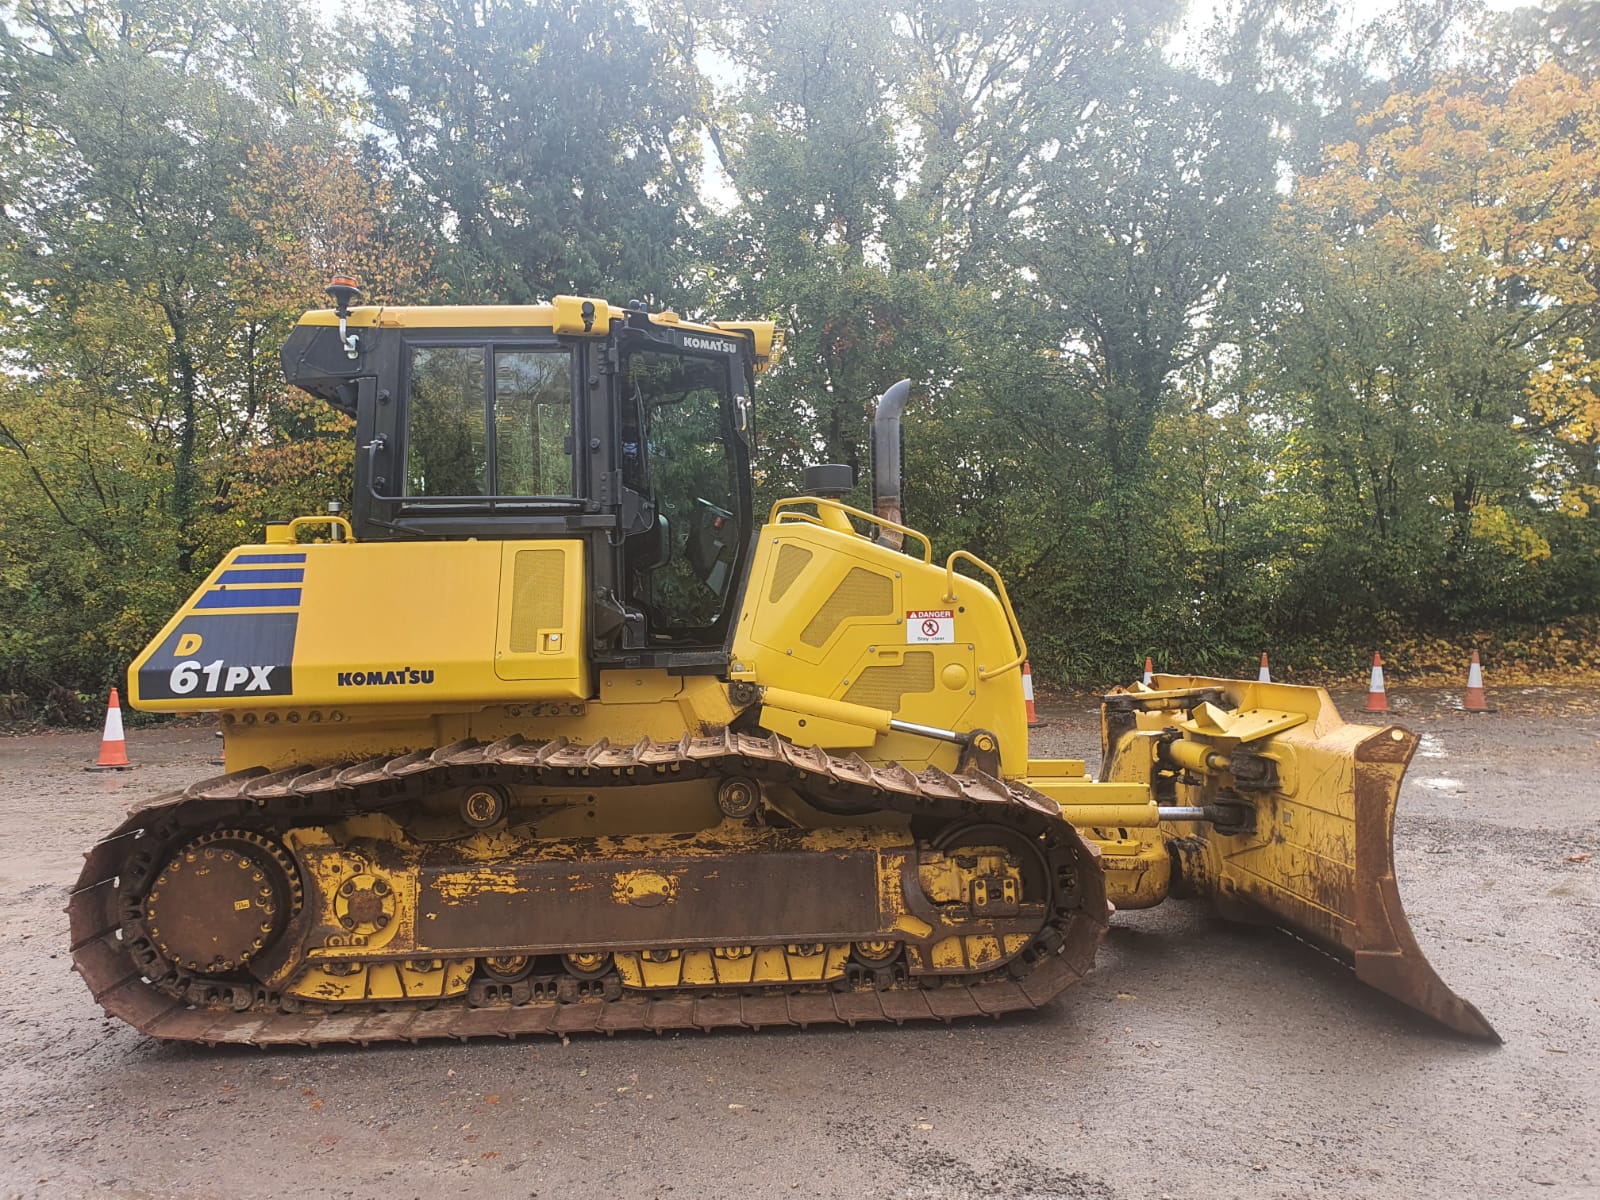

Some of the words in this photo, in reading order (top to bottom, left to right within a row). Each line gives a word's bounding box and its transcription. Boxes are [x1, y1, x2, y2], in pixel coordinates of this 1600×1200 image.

[683, 336, 737, 353] KOMATSU
[173, 633, 203, 657] D
[169, 660, 275, 694] 61PX
[337, 666, 434, 686] KOMATSU
